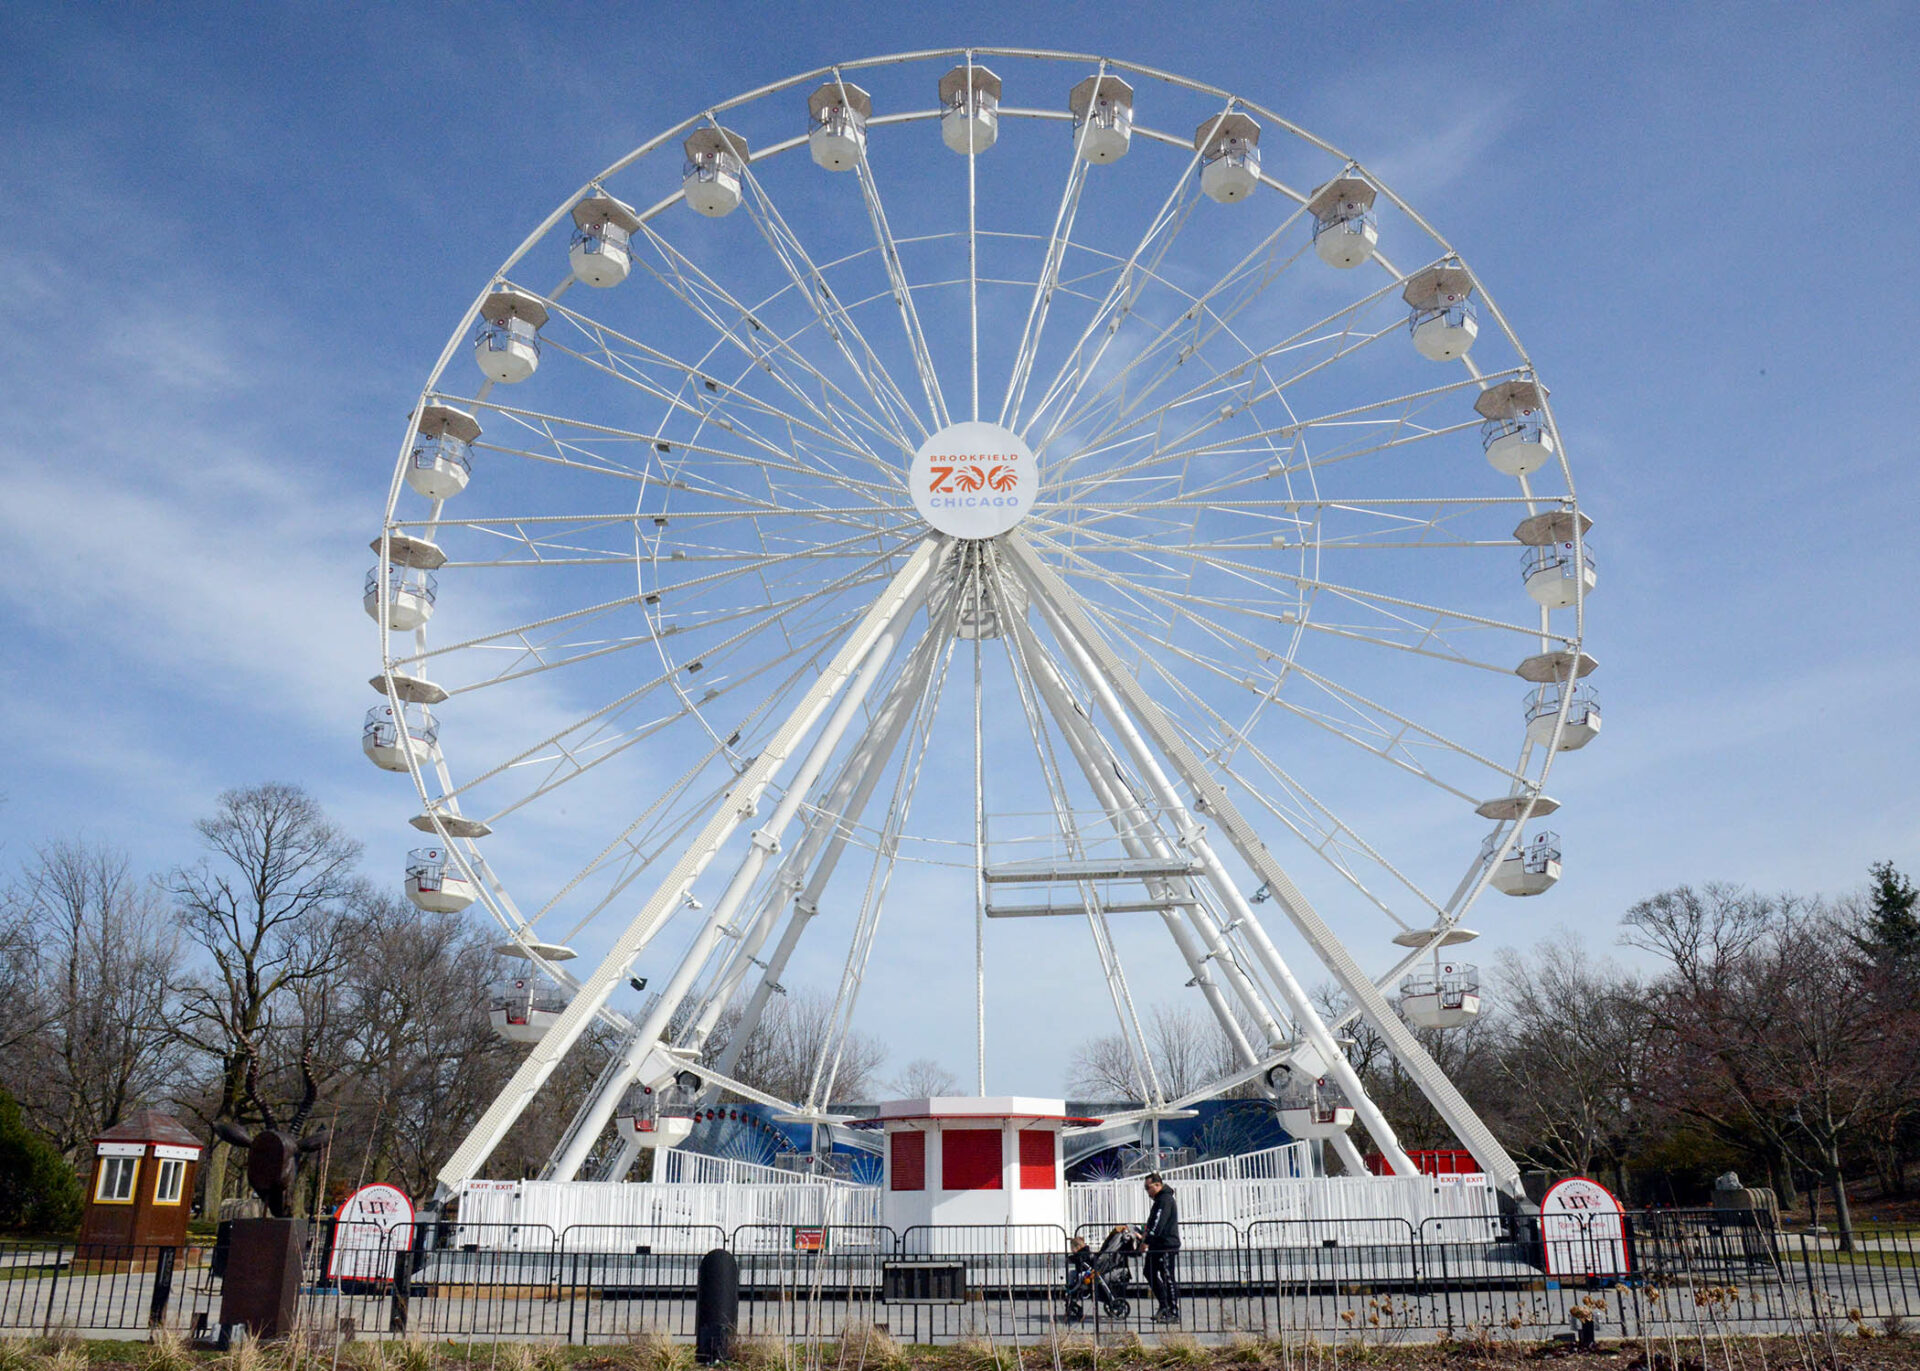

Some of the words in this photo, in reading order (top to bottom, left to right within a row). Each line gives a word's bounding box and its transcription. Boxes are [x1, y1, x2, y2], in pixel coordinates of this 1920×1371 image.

[930, 454, 1018, 462] BROOKFIELD
[929, 465, 1018, 493] ZOO
[930, 497, 1019, 508] CHICAGO
